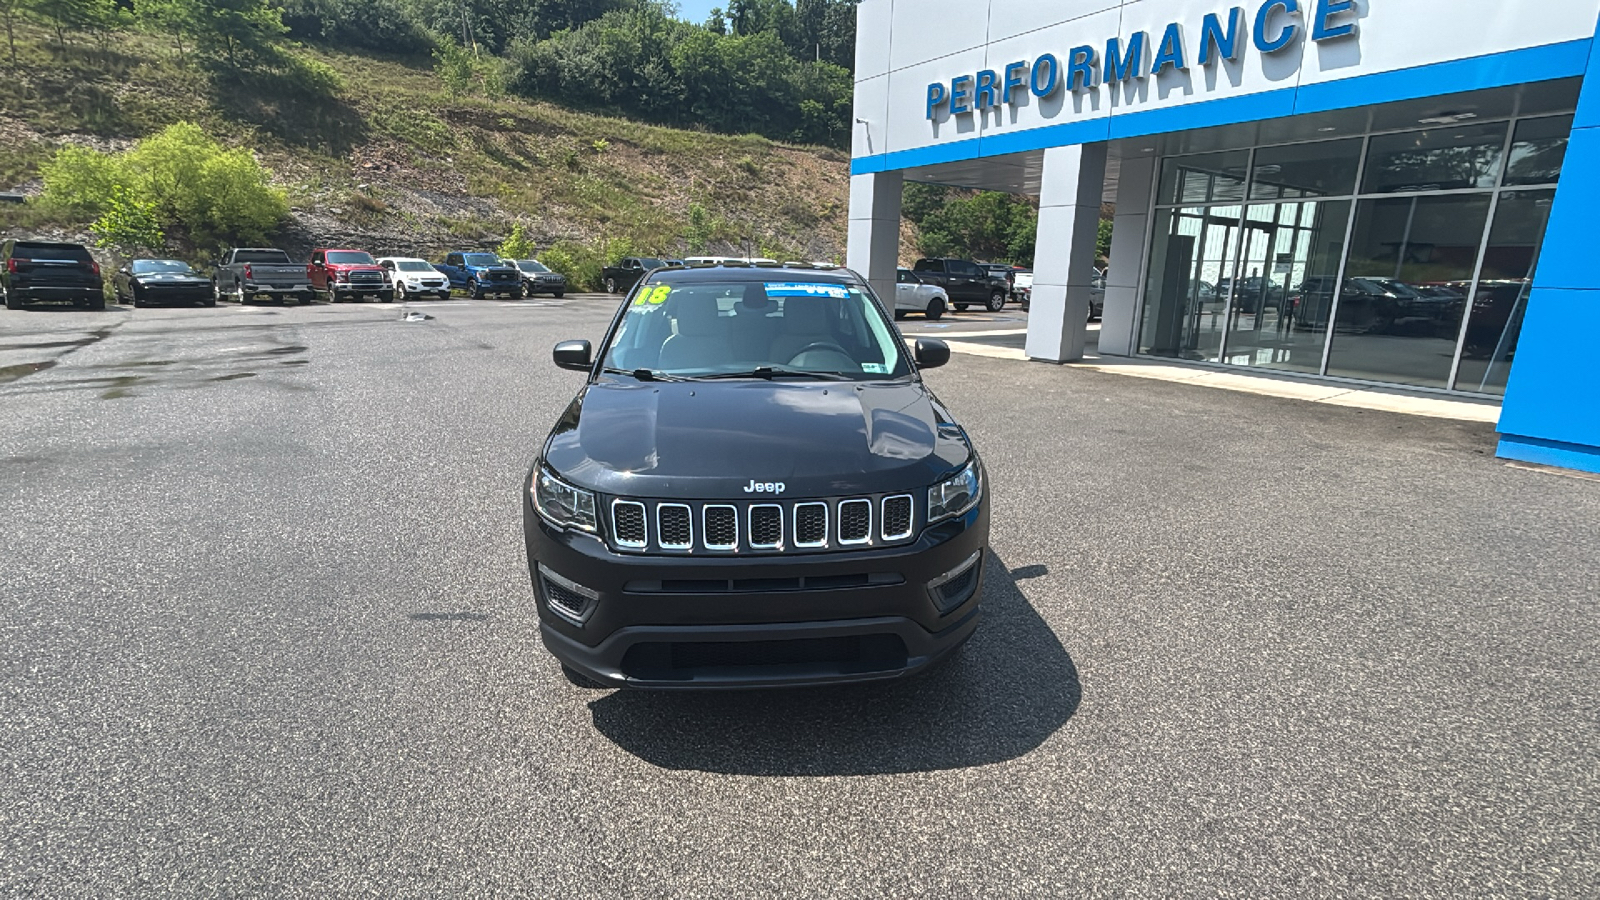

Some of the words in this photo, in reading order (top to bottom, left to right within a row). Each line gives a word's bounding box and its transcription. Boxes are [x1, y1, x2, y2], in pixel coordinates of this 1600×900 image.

[926, 0, 1355, 120] PERFORMANCE
[635, 286, 671, 306] 18
[743, 479, 786, 495] Jeep
